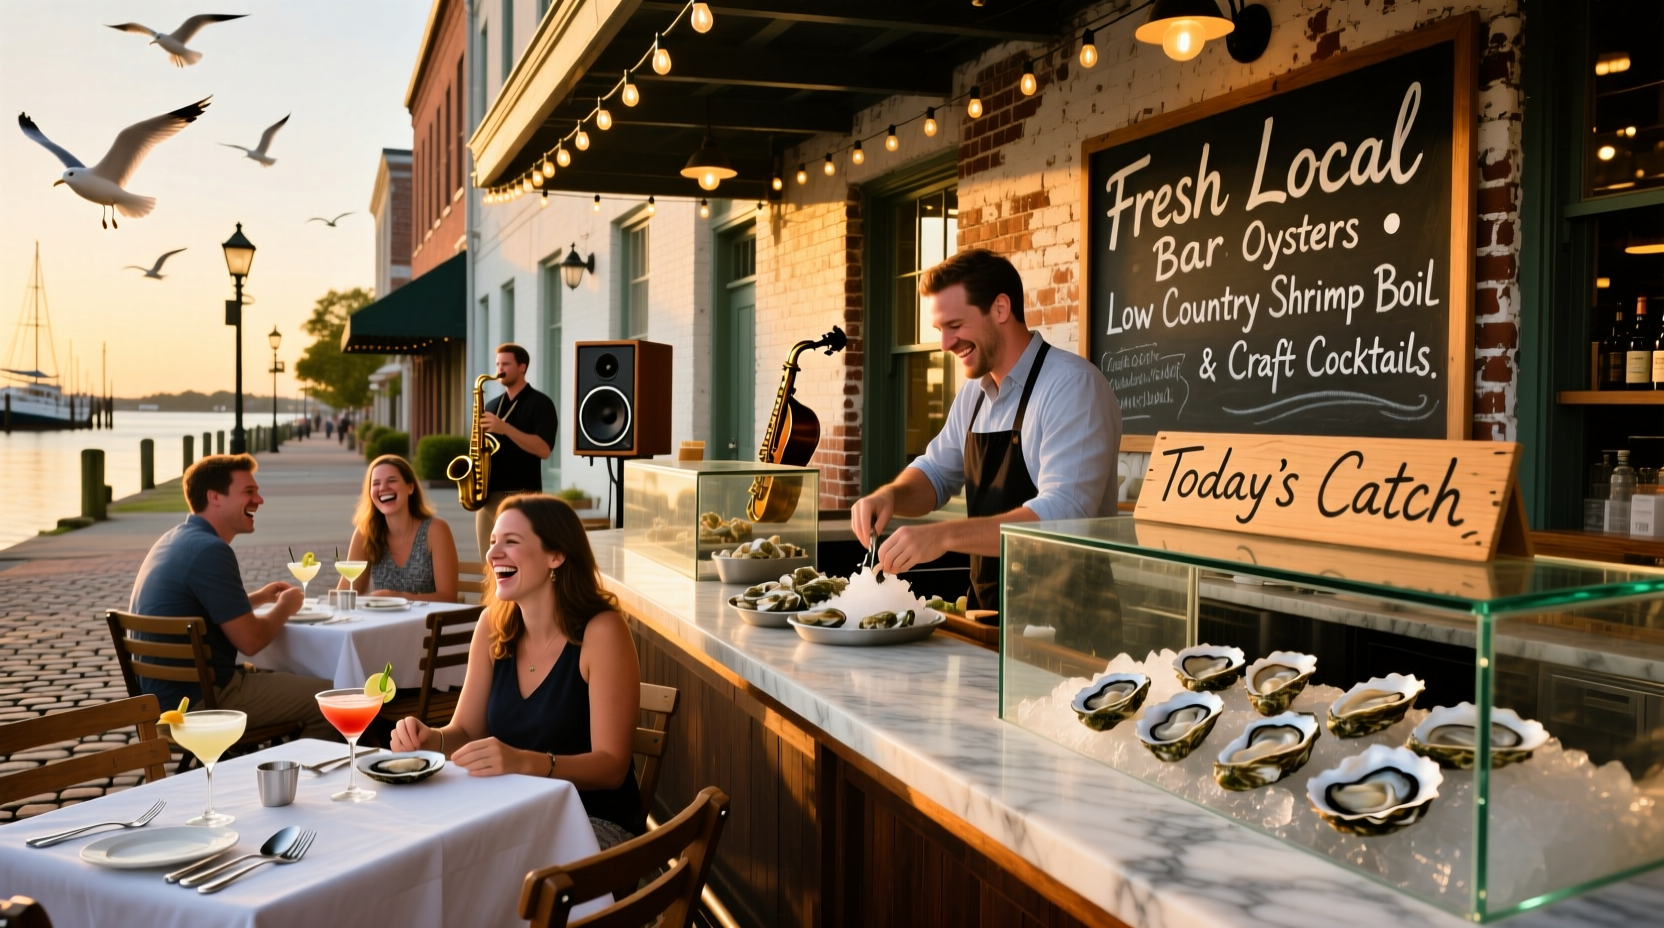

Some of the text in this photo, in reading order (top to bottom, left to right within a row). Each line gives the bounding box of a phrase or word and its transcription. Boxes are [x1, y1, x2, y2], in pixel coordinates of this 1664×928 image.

[1105, 81, 1424, 251] Fresh Local
[1152, 214, 1359, 282] Bar Oysters
[1106, 258, 1440, 336] Low Country Shrimp Boil
[1198, 347, 1217, 382] &
[1228, 337, 1297, 394] Craft
[1305, 331, 1438, 380] Cocktails.
[1161, 445, 1299, 524] Today's
